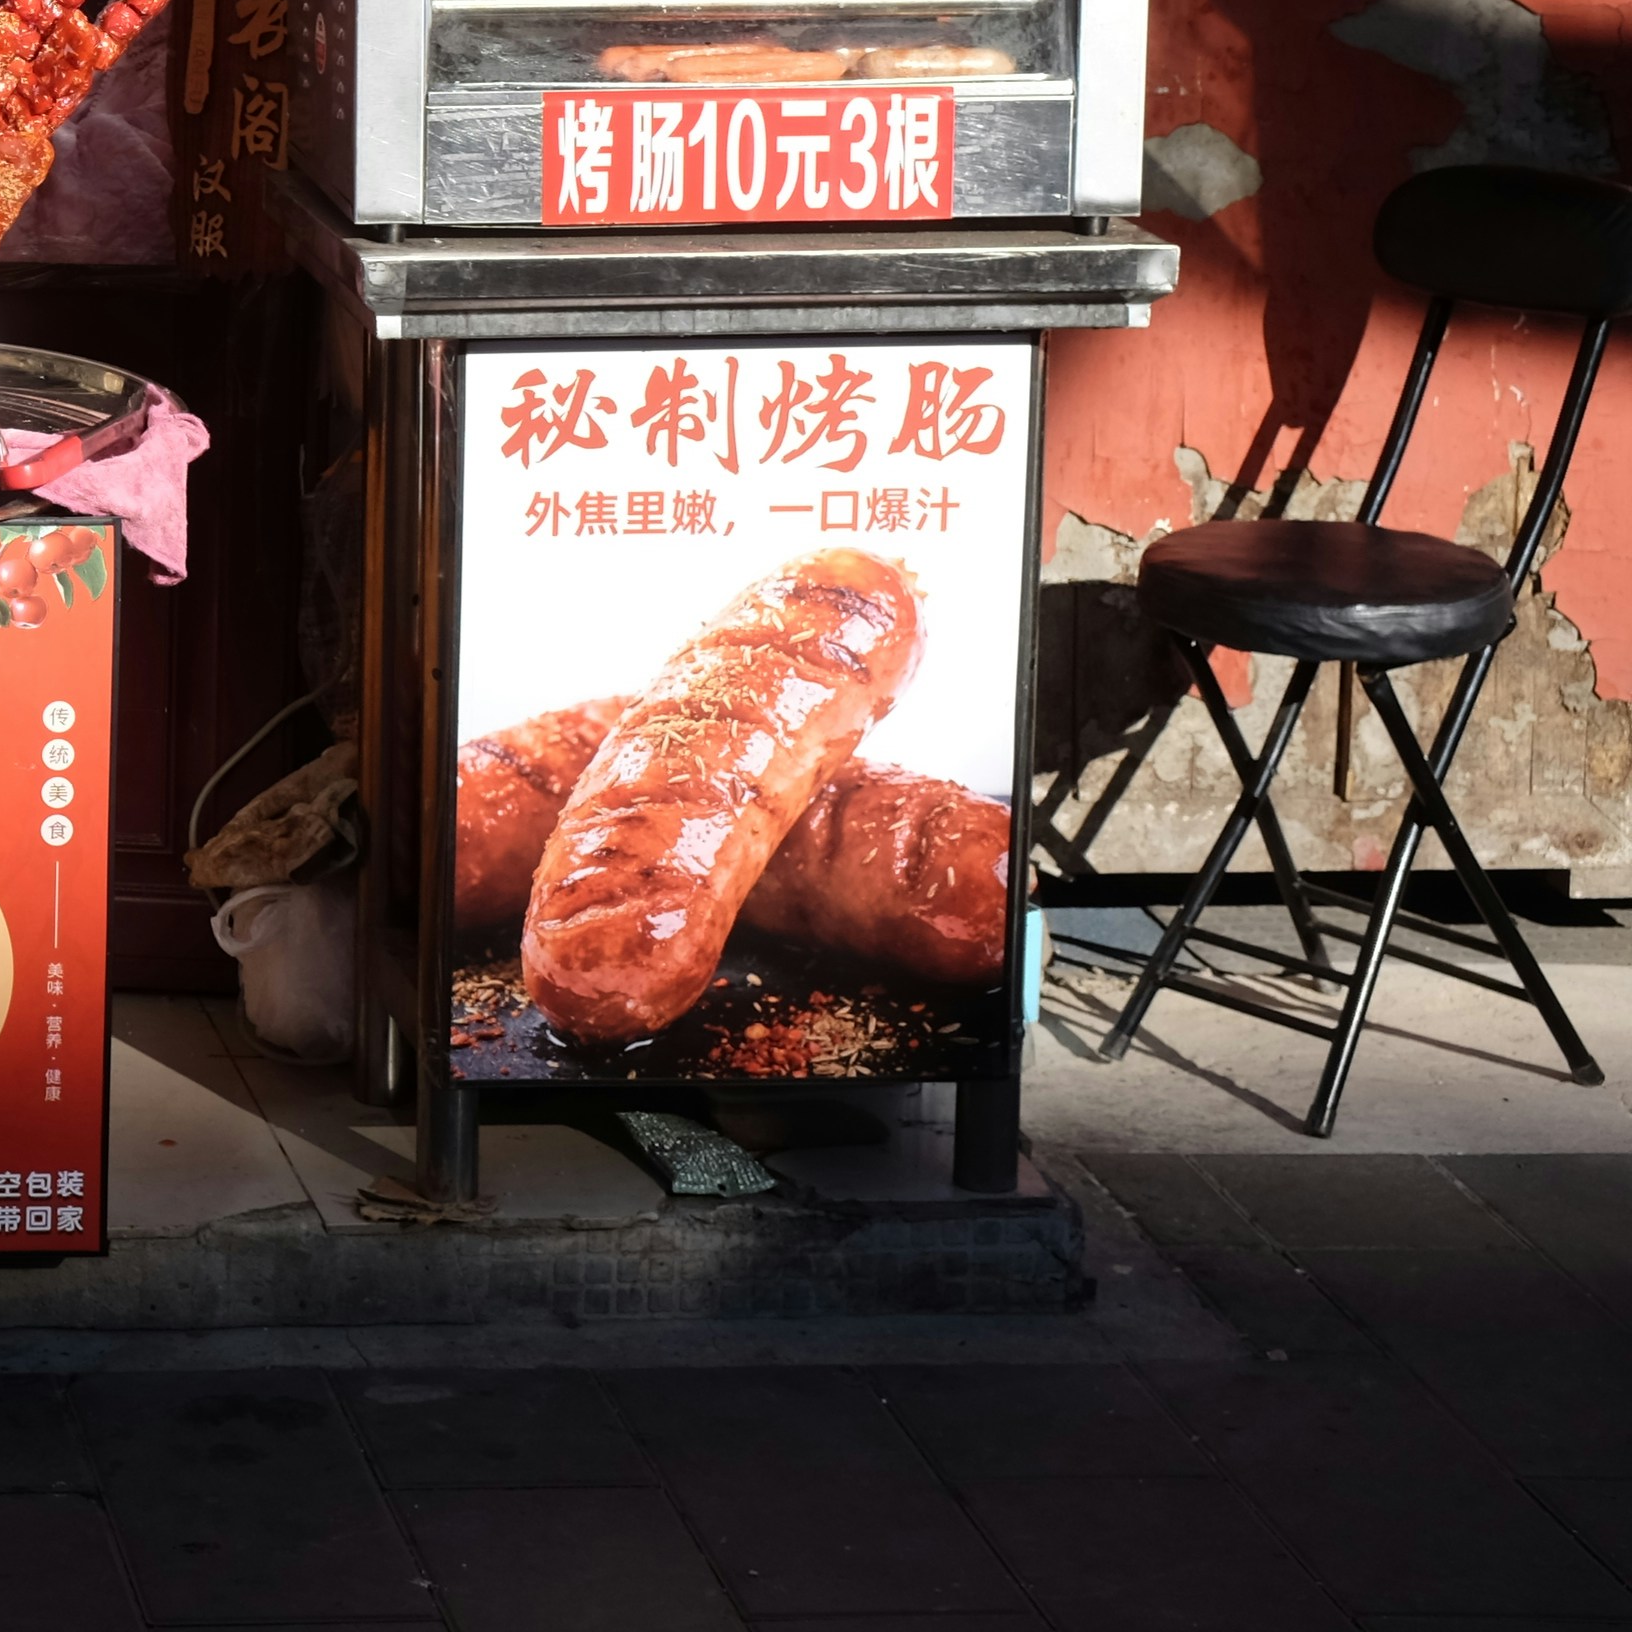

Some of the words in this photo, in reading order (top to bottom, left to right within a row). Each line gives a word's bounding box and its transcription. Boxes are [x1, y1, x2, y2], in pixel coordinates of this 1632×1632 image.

[190, 155, 231, 259] 汉服
[558, 93, 941, 214] 烤肠10元3根
[500, 353, 1006, 475] 秘制烤肠
[48, 707, 70, 840] 传统美食
